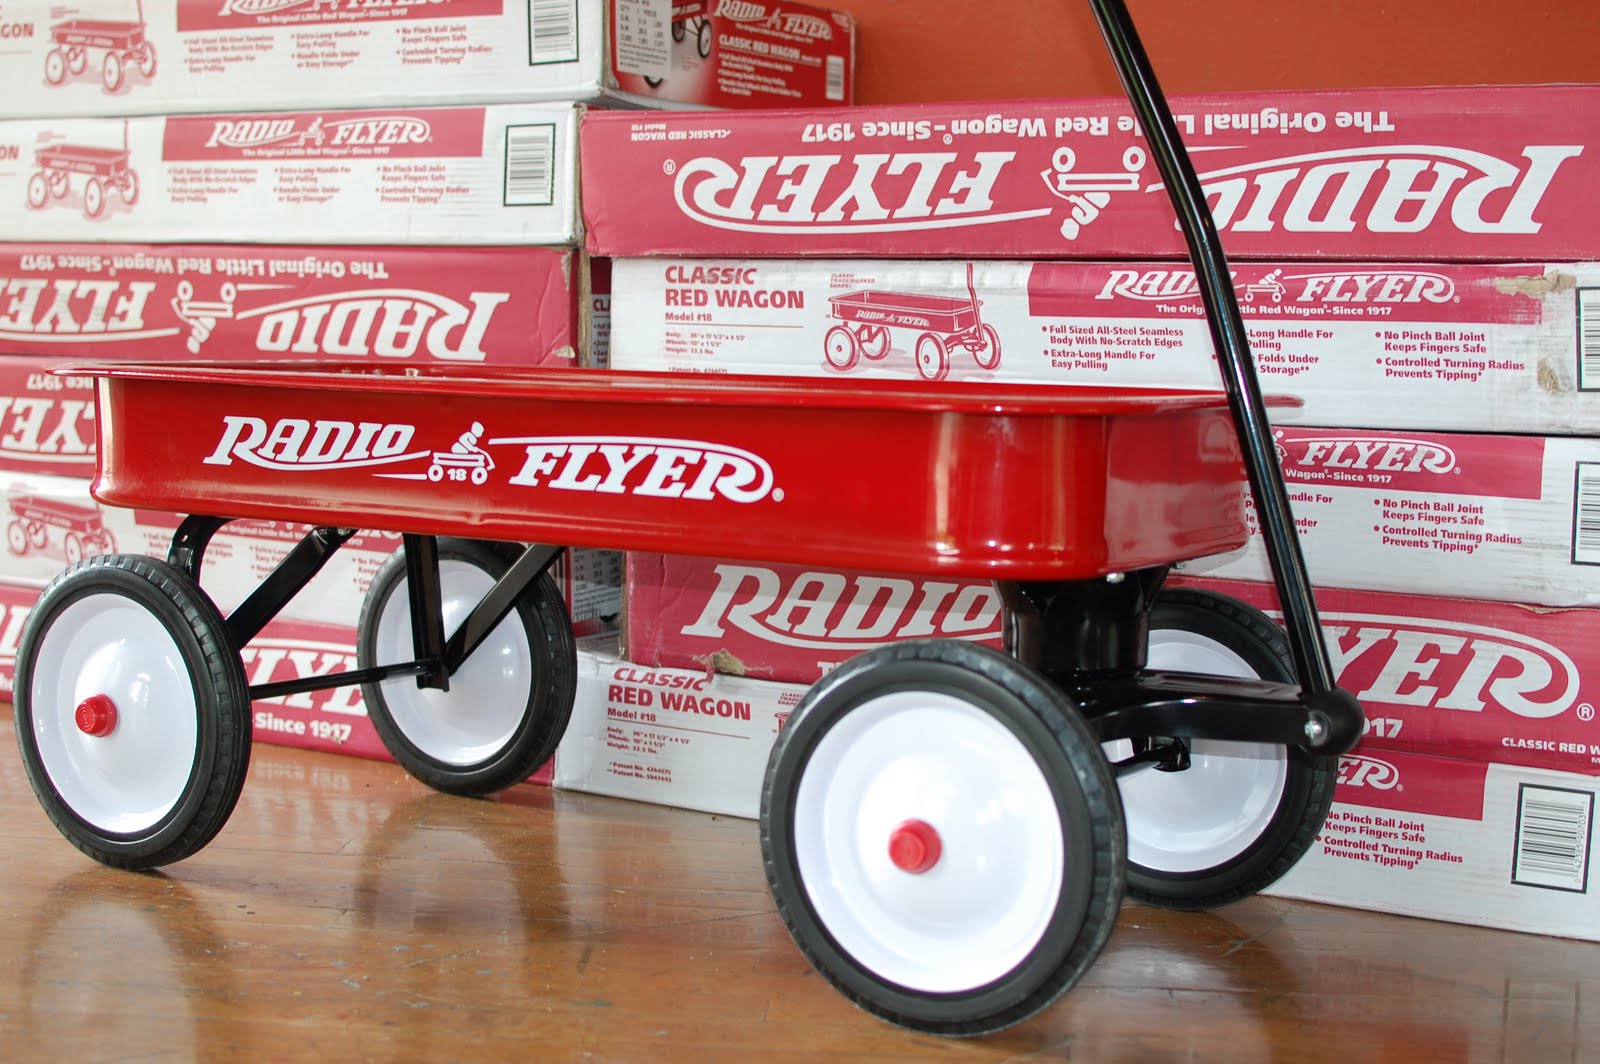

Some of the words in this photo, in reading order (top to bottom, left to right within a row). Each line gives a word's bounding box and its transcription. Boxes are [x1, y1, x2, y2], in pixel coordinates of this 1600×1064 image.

[719, 34, 752, 50] CLASSIC
[753, 41, 769, 54] RED
[770, 43, 801, 60] WAGON
[1055, 116, 1109, 137] Red
[1206, 111, 1327, 137] Original
[1336, 110, 1395, 133] The
[204, 118, 300, 148] RADIO
[631, 131, 667, 142] WAGON
[668, 130, 687, 141] RED
[802, 122, 854, 143] 1917
[20, 254, 55, 271] 1917
[176, 257, 213, 275] Red
[215, 257, 265, 277] Little
[269, 256, 346, 280] Original
[349, 259, 389, 280] The
[665, 265, 757, 285] CLASSIC
[1094, 270, 1238, 301] RAD
[665, 288, 709, 307] RED
[715, 290, 805, 309] WAGON
[0, 277, 180, 342] FLYE
[665, 312, 695, 322] Model
[697, 312, 713, 322] #18
[1155, 304, 1176, 314] The
[1179, 304, 1205, 315] Orig
[1239, 305, 1256, 315] ttle
[1259, 305, 1282, 315] Red
[1366, 306, 1392, 316] 1917
[236, 288, 511, 361] RADIO
[1049, 325, 1067, 335] Full
[1069, 325, 1094, 335] Sized
[1096, 326, 1137, 336] All-Steel
[1139, 327, 1184, 337] Seamless
[1050, 335, 1074, 346] Body
[1075, 335, 1098, 345] With
[1100, 336, 1151, 347] No-Scratch
[1154, 337, 1183, 348] Edges
[1277, 329, 1314, 339] Handle
[1316, 330, 1334, 339] For
[1384, 331, 1399, 340] No
[1402, 331, 1431, 341] Pinch
[1434, 331, 1456, 341] Ball
[1458, 332, 1486, 342] Joint
[1051, 349, 1102, 361] Extra-Long
[1104, 350, 1137, 360] Handle
[1139, 351, 1156, 360] For
[1384, 342, 1417, 353] Keeps
[1419, 342, 1460, 354] Fingers
[1462, 343, 1487, 353] Safe
[1051, 360, 1073, 370] Easy
[1075, 360, 1108, 371] Pulling
[1258, 354, 1286, 364] Folds
[1288, 354, 1320, 364] Under
[1385, 358, 1441, 368] Controlled
[1443, 359, 1486, 371] Turning
[1488, 360, 1525, 371] Radius
[1385, 368, 1433, 379] Prevents
[202, 415, 431, 471] RADIO
[446, 468, 467, 481] 18
[1366, 473, 1392, 484] 1917
[1288, 493, 1313, 503] ndle
[1315, 494, 1333, 504] For
[1383, 499, 1398, 509] No
[1400, 500, 1431, 511] Pinch
[1433, 501, 1455, 513] Ball
[1456, 503, 1484, 515] Joint
[1295, 518, 1318, 528] nder
[1383, 510, 1416, 523] Keeps
[1417, 512, 1459, 526] Fingers
[1460, 515, 1485, 526] Safe
[1382, 525, 1439, 538] Controlled
[1440, 528, 1483, 544] Turning
[1485, 532, 1523, 545] Radius
[1382, 535, 1430, 549] Prevents
[680, 564, 1003, 650] RADIO
[613, 667, 708, 692] CLASSIC
[608, 684, 653, 707] RED
[660, 692, 751, 721] WAGON
[607, 707, 637, 720] Model
[640, 711, 657, 722] #18
[255, 712, 306, 735] Since
[310, 719, 353, 743] 1917
[1502, 736, 1555, 752] CLASSIC
[1558, 741, 1586, 755] RED
[1342, 812, 1372, 825] Pinch
[1374, 816, 1396, 829] Ball
[1398, 820, 1425, 832] Joint
[1324, 821, 1357, 835] Keeps
[1358, 825, 1399, 840] Fingers
[1401, 830, 1425, 844] Safe
[1324, 835, 1379, 852] Controlled
[1381, 843, 1423, 860] Turning
[1426, 850, 1463, 864] Radius
[1324, 846, 1371, 862] Prevents
